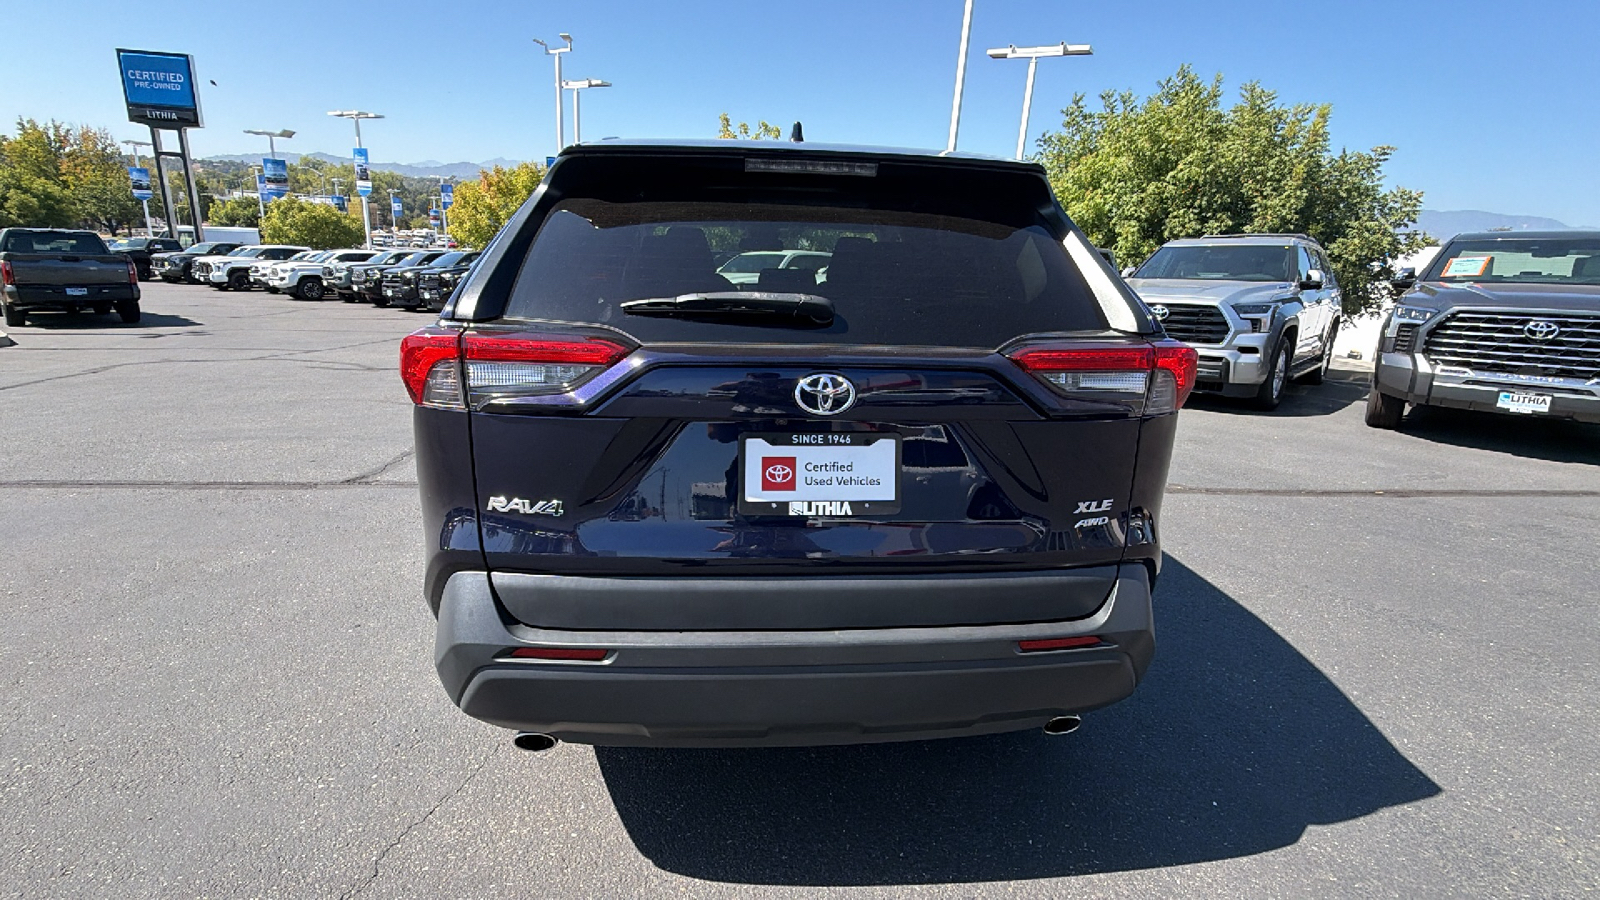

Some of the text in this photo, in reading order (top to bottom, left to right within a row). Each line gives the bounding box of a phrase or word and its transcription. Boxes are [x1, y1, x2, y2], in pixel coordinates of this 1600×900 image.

[128, 70, 184, 82] CERTIFIED
[134, 81, 181, 91] PRE-OWNED
[146, 110, 178, 120] LITHIA
[1511, 395, 1547, 406] LITHIA
[791, 434, 851, 444] SINCE 1946
[804, 462, 853, 473] Certified
[804, 476, 881, 486] Used Vehicles
[486, 496, 564, 517] RAV4
[803, 501, 853, 516] LITHIA
[1073, 498, 1114, 514] XLE
[1074, 516, 1109, 529] AWD
